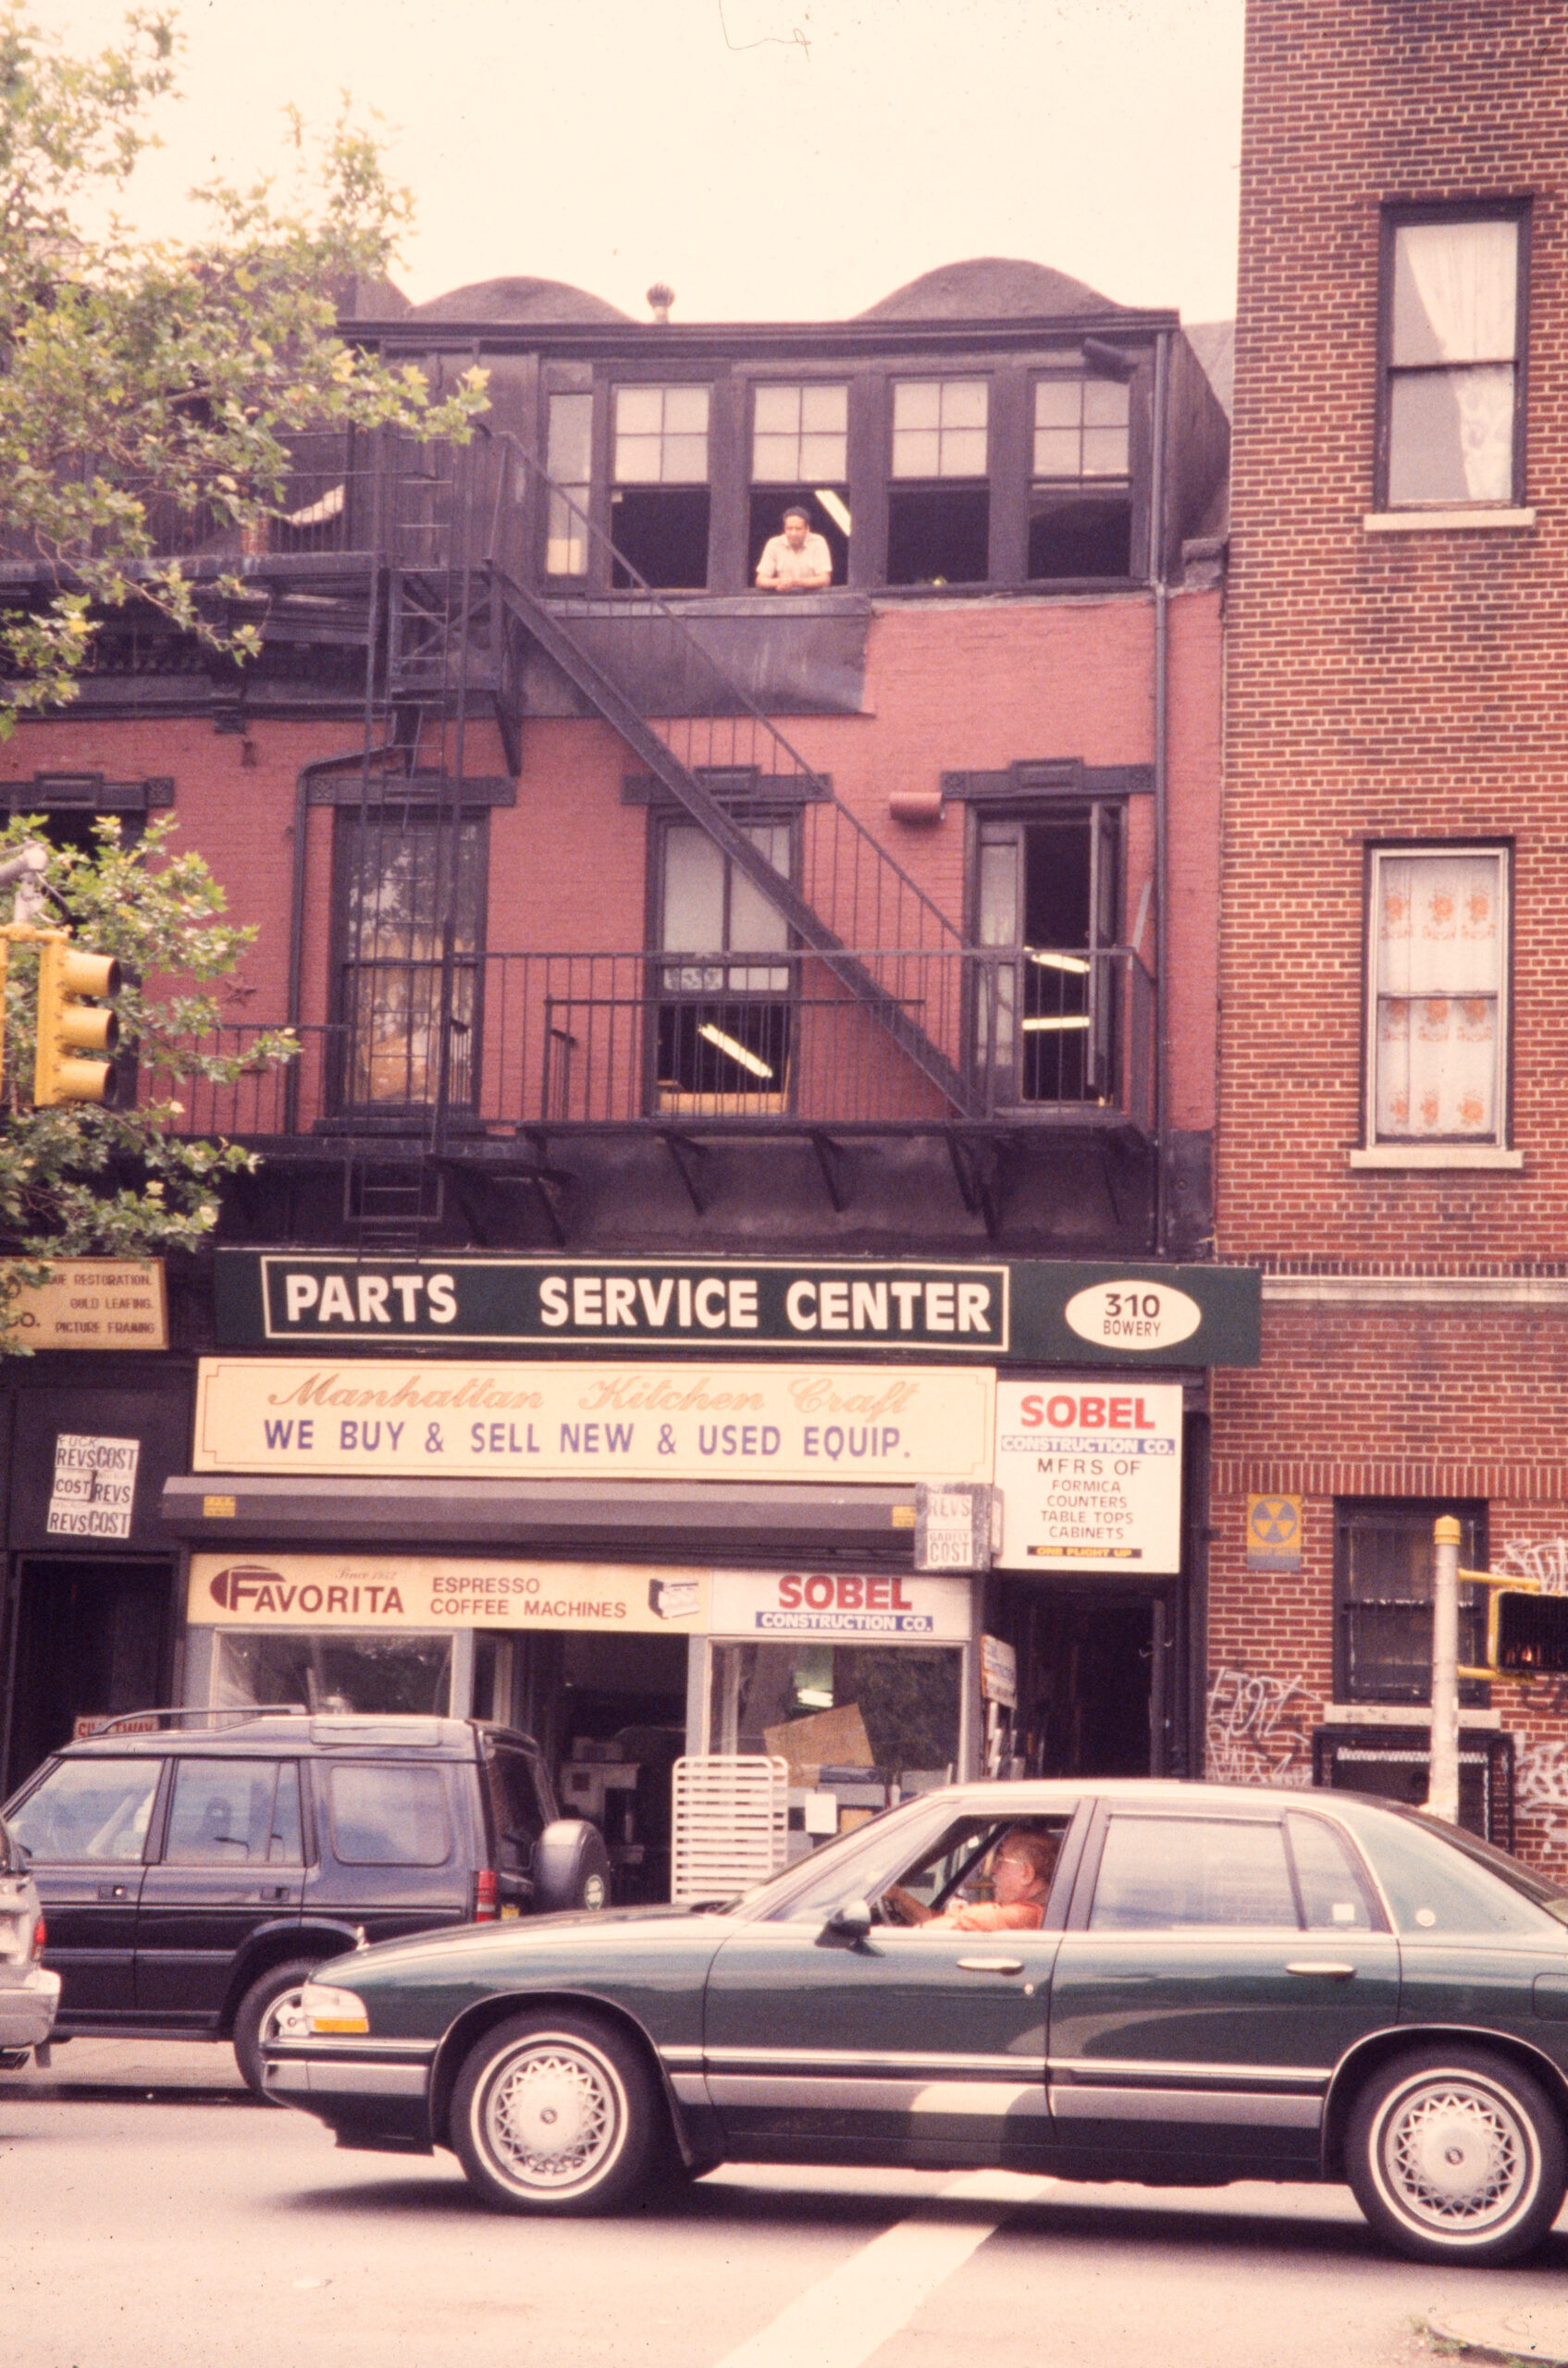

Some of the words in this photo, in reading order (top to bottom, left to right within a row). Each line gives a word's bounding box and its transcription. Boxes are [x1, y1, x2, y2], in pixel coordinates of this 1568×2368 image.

[285, 1274, 458, 1324] PARTS
[538, 1276, 759, 1329] SERVICE
[785, 1279, 992, 1332] CENTER
[1105, 1293, 1160, 1318] 310
[56, 1321, 100, 1334] PICTURE
[107, 1322, 155, 1334] FRAMING
[1104, 1320, 1161, 1338] BOWERY
[267, 1373, 545, 1410] Manhattan
[577, 1375, 766, 1412] Kitchen
[787, 1377, 920, 1424] Craft
[1020, 1395, 1155, 1430] SOBEL
[264, 1420, 314, 1450] WE
[340, 1421, 405, 1451] BUY
[425, 1422, 445, 1453] &
[471, 1423, 540, 1453] SELL
[560, 1423, 635, 1453] NEW
[657, 1423, 677, 1455] &
[698, 1424, 781, 1456] USED
[803, 1425, 910, 1462] EQUIP.
[1002, 1436, 1138, 1454] CONSTRUCTION
[1143, 1438, 1175, 1455] CO.
[56, 1448, 96, 1468] REVS
[97, 1446, 138, 1471] COST
[1037, 1458, 1104, 1475] MFRS
[1114, 1460, 1142, 1476] OF
[56, 1479, 90, 1495] COST
[94, 1483, 131, 1503] REVS
[1052, 1479, 1122, 1494] FORMICA
[1046, 1495, 1128, 1509] COUNTERS
[49, 1512, 88, 1533] REVS
[89, 1510, 130, 1535] COST
[1041, 1510, 1087, 1523] TABLE
[1093, 1511, 1134, 1524] TOPS
[1049, 1525, 1125, 1540] CABINETS
[930, 1541, 969, 1562] COST
[1036, 1546, 1063, 1556] ONE
[1066, 1548, 1111, 1557] FLIGHT
[1113, 1548, 1132, 1558] UP
[228, 1572, 405, 1614] FAVORITA
[432, 1576, 540, 1594] ESPRESSO
[778, 1575, 912, 1610] SOBEL
[430, 1598, 509, 1615] COFFEE
[524, 1600, 627, 1619] MACHINES
[761, 1613, 896, 1630] CONSTRUCTION
[902, 1616, 932, 1632] CO.
